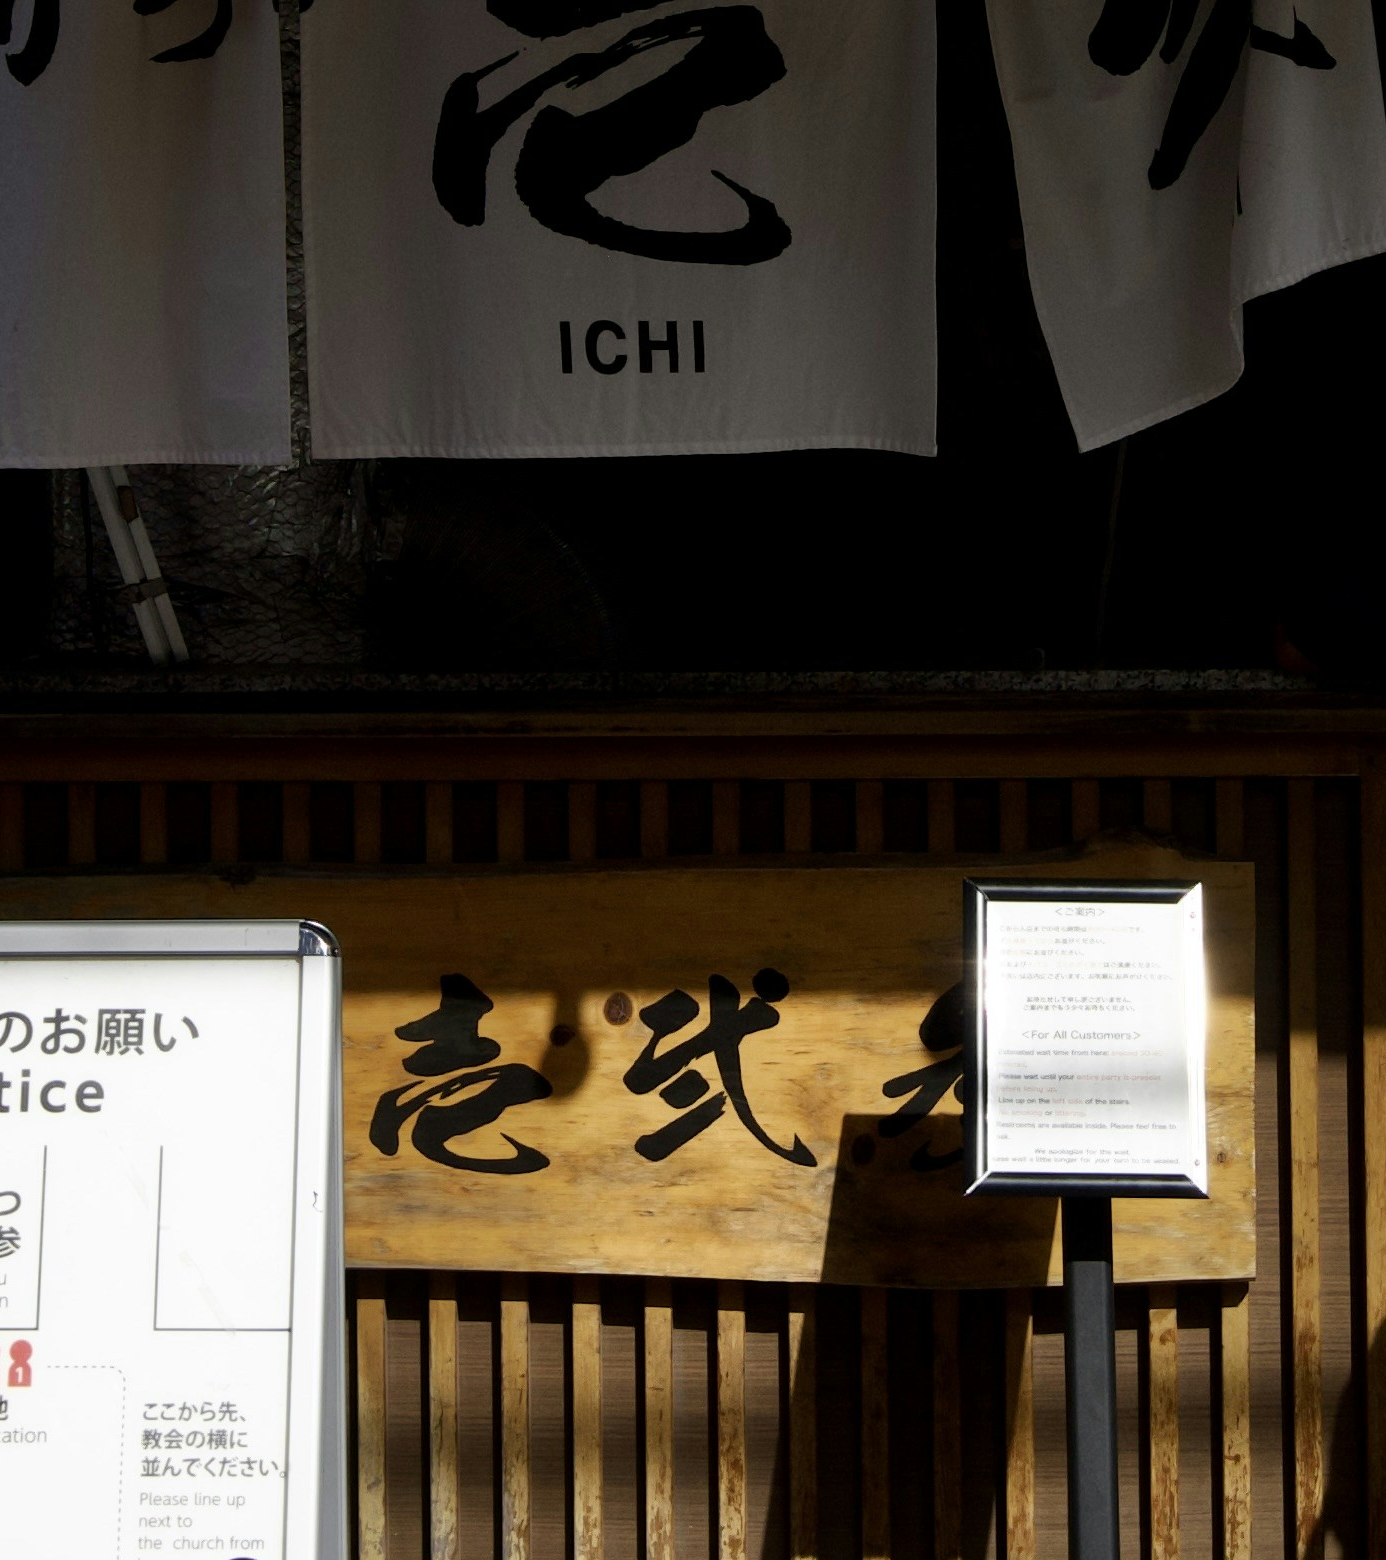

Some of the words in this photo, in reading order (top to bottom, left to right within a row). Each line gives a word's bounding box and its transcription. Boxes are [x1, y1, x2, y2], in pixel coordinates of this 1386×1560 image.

[559, 320, 706, 375] ICHI
[1053, 1030, 1067, 1040] All
[1058, 1073, 1075, 1082] your
[16, 1367, 23, 1382] 1
[142, 1428, 248, 1450] 教会の横に
[139, 1492, 188, 1506] Please
[194, 1492, 221, 1506] line
[227, 1495, 246, 1509] up
[139, 1515, 171, 1528] next
[177, 1516, 193, 1528] to
[138, 1536, 163, 1550] the
[172, 1536, 224, 1550] church
[230, 1536, 265, 1550] from
